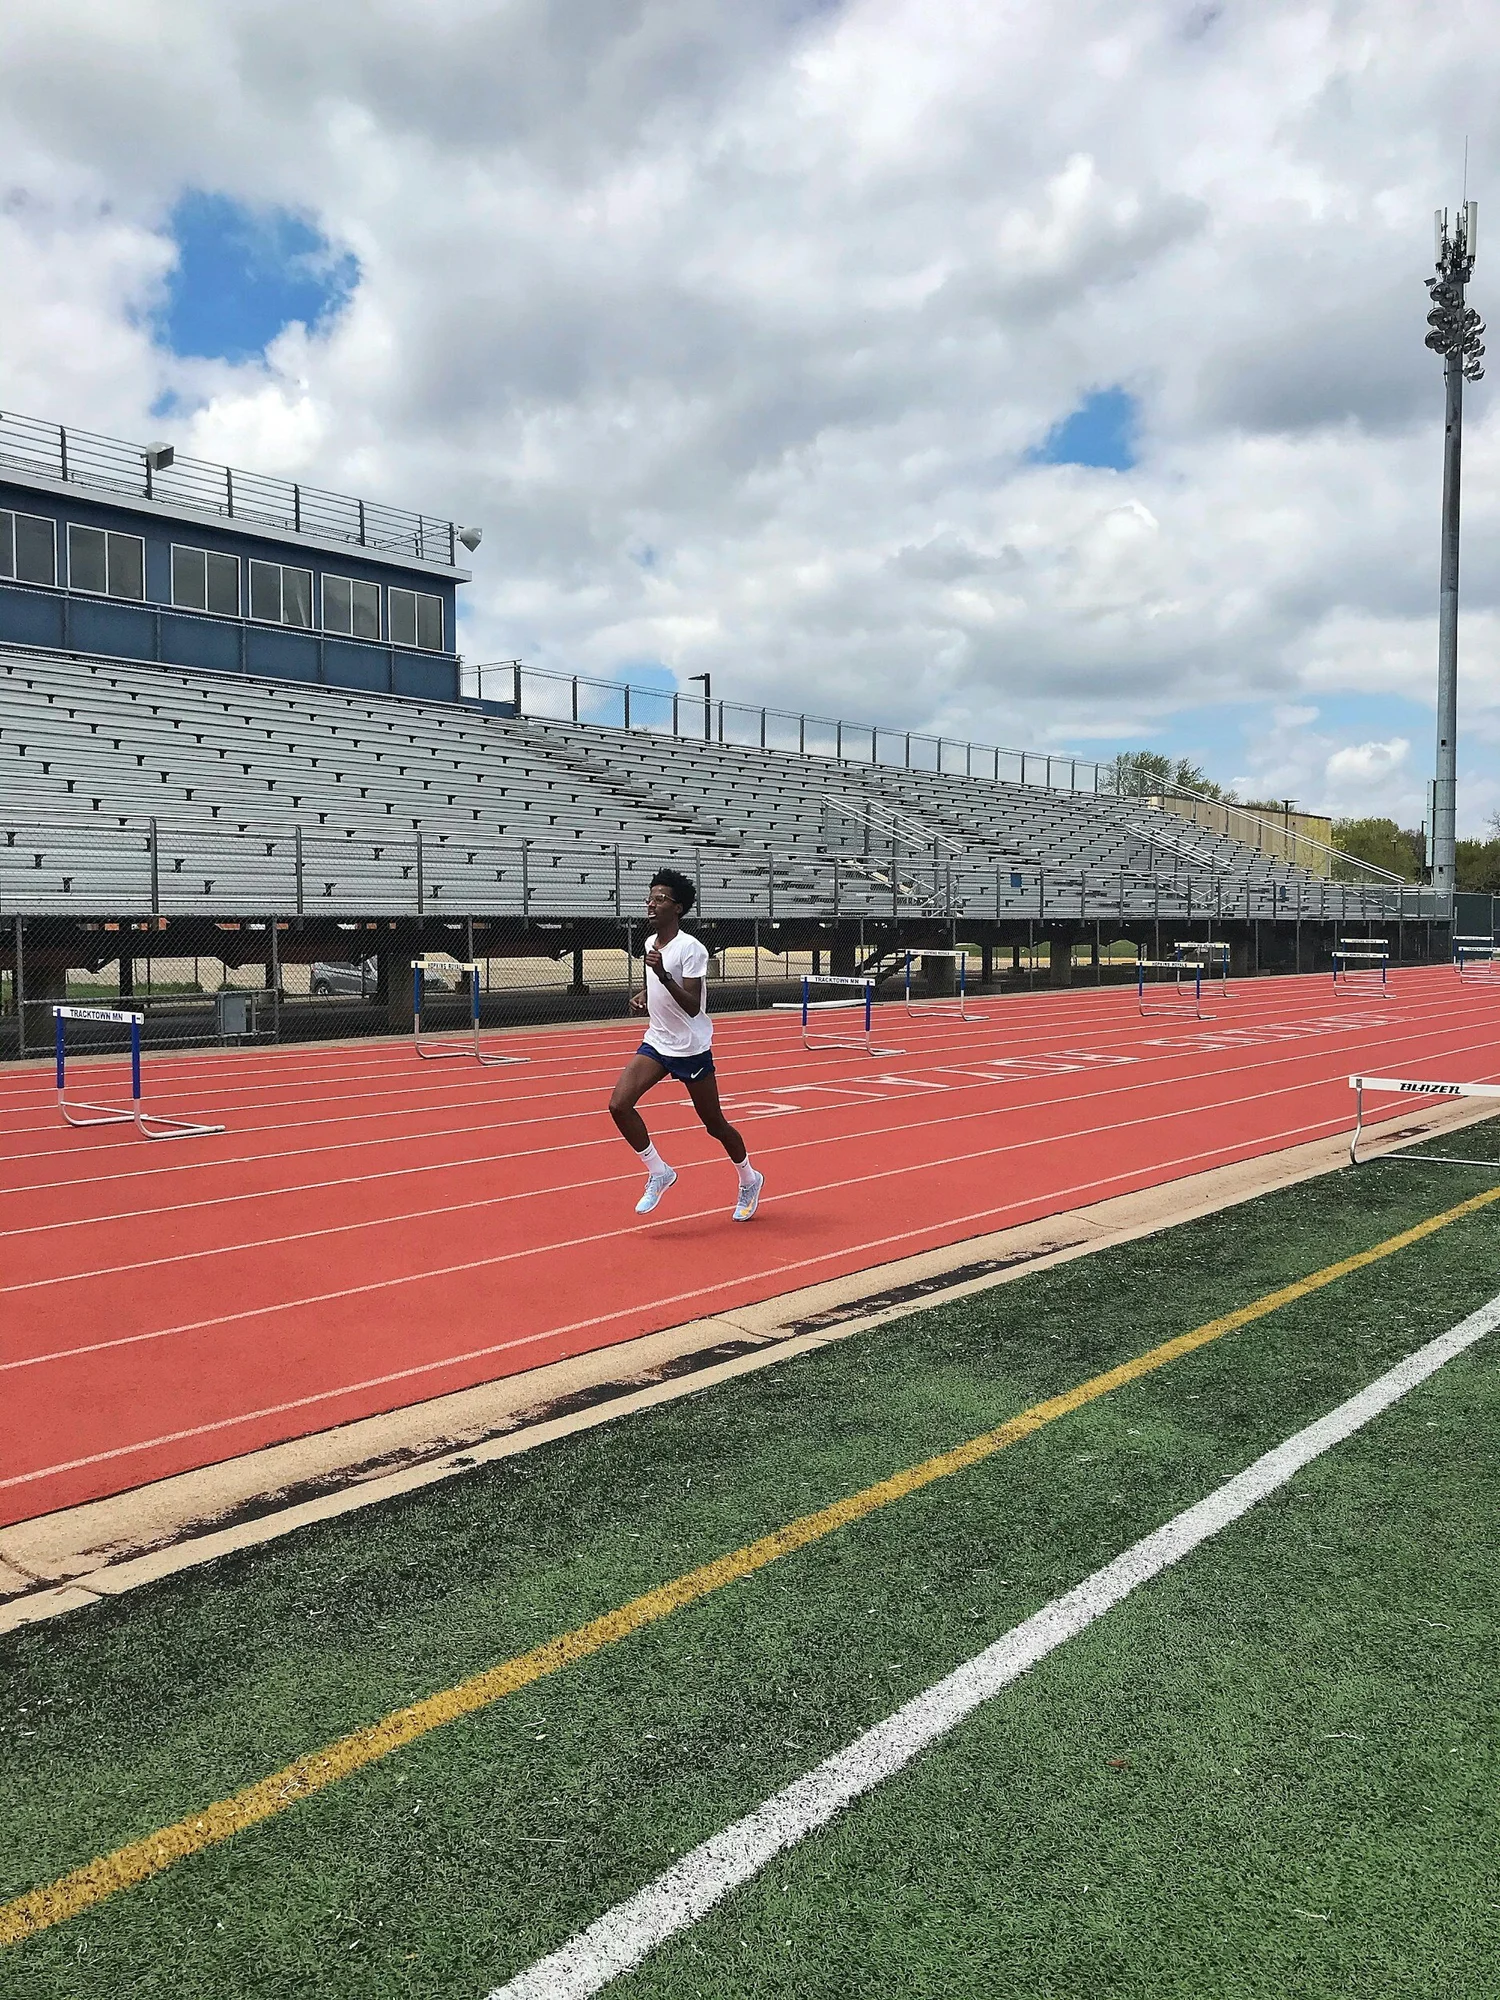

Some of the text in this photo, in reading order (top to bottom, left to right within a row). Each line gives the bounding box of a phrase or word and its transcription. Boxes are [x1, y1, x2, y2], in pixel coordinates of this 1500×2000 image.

[815, 976, 849, 984] TRACKTOWN
[69, 1009, 123, 1021] TRACKTOWN MN
[680, 1013, 1415, 1115] HOPKINS ROYALS
[1400, 1082, 1461, 1094] BLAZER
